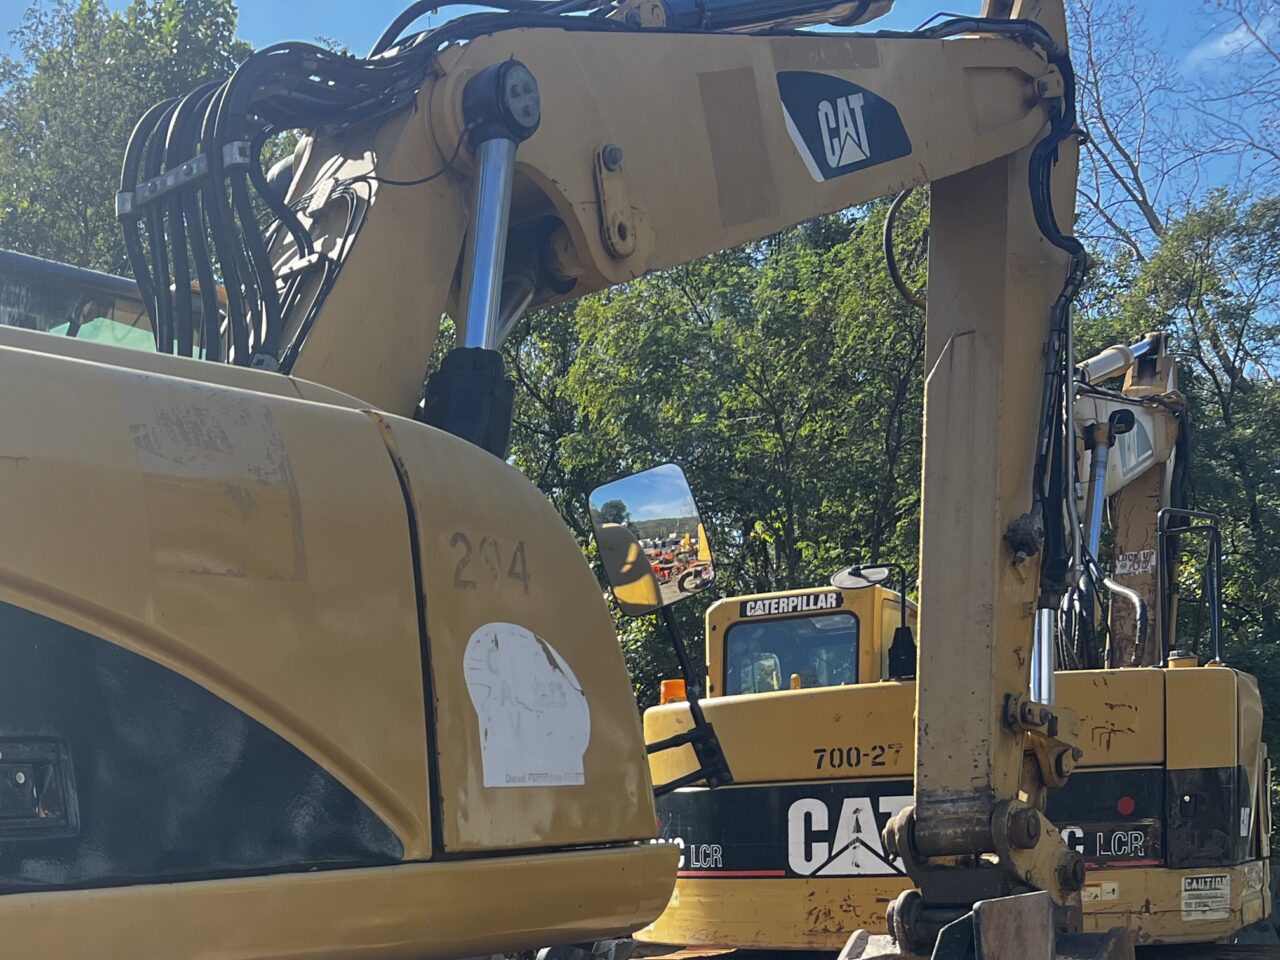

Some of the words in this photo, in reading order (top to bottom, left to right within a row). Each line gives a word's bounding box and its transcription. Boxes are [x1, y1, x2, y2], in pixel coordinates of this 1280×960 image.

[818, 92, 870, 168] CAT
[746, 592, 837, 616] CATERPILLAR
[1096, 831, 1145, 856] LCR
[690, 844, 723, 868] LCR
